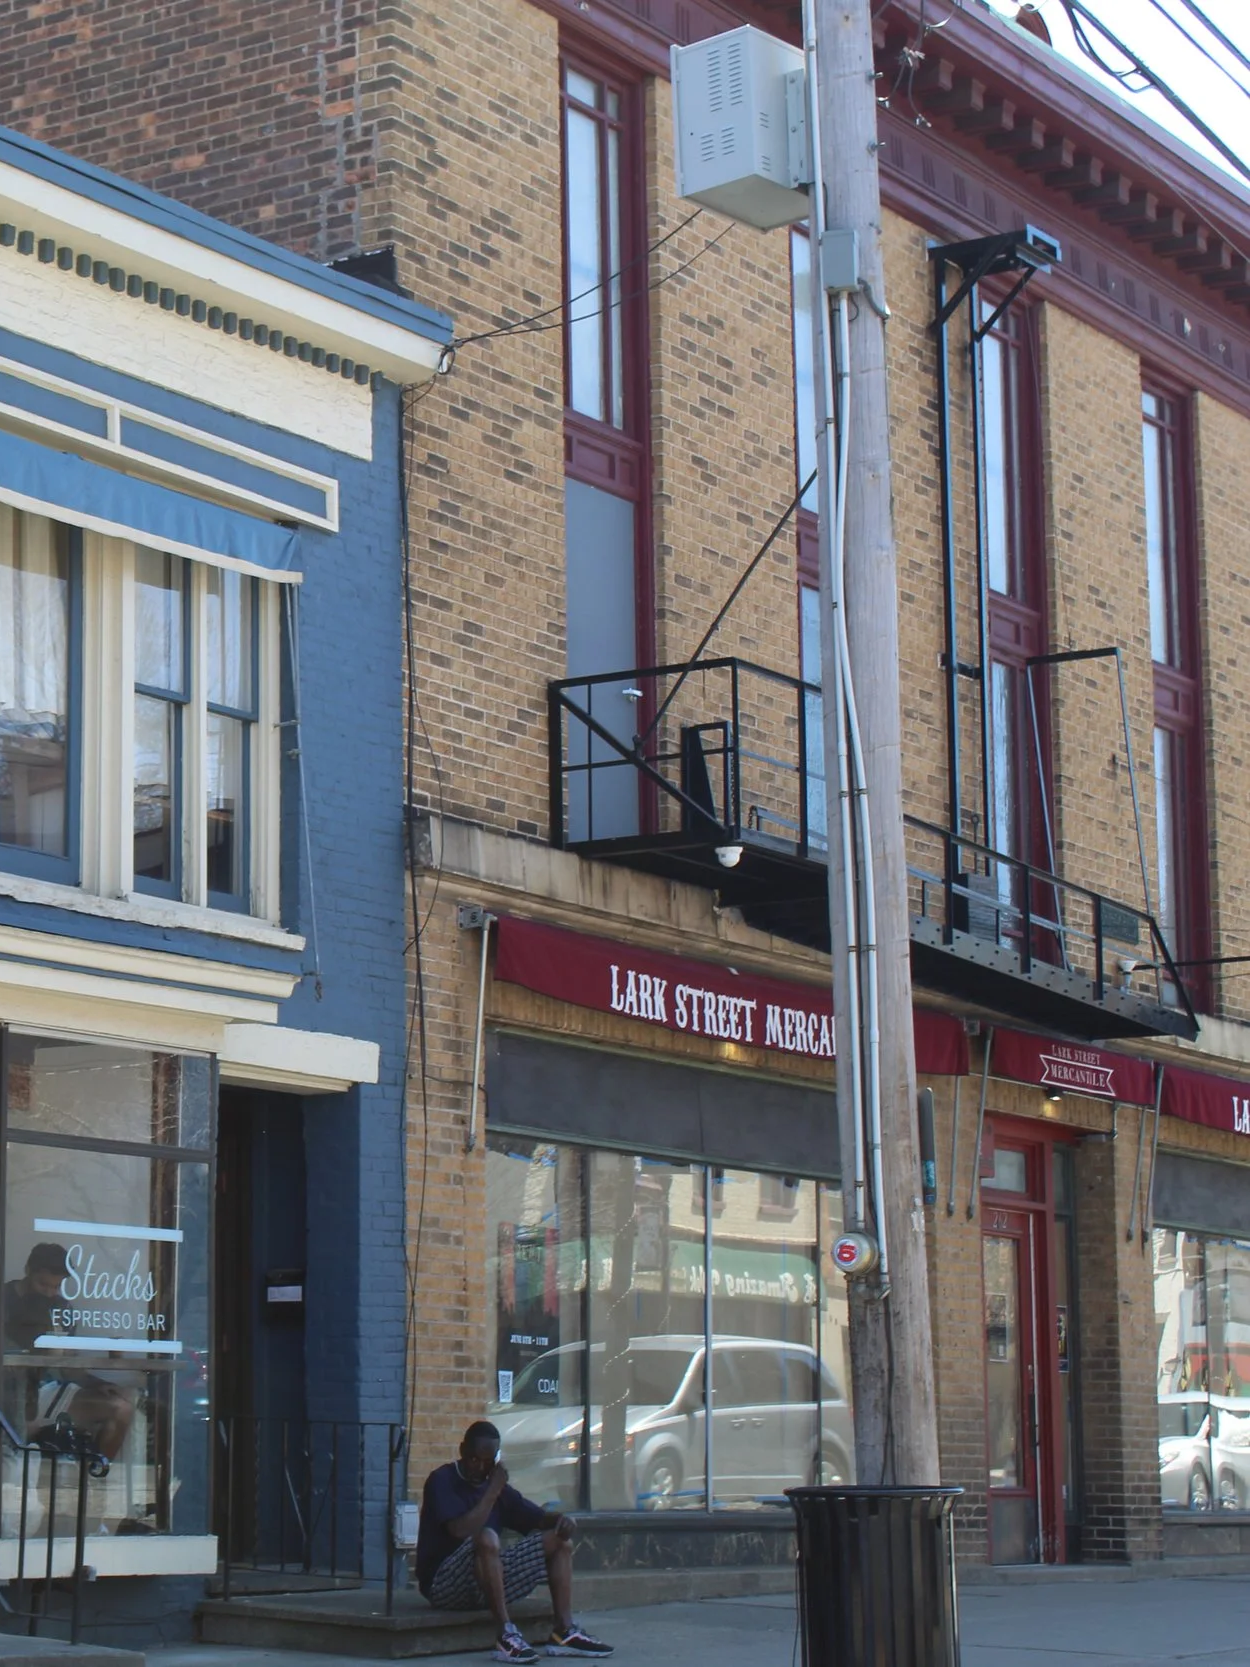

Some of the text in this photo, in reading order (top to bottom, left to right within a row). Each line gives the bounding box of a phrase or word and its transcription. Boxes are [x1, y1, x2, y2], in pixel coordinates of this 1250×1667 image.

[610, 964, 668, 1023] LARK
[675, 984, 757, 1042] STREET
[1051, 1044, 1100, 1065] LARK STREET
[1051, 1064, 1105, 1087] MERCANTILE
[60, 1244, 158, 1302] Stacks
[52, 1308, 166, 1331] ESPRESSO BAR
